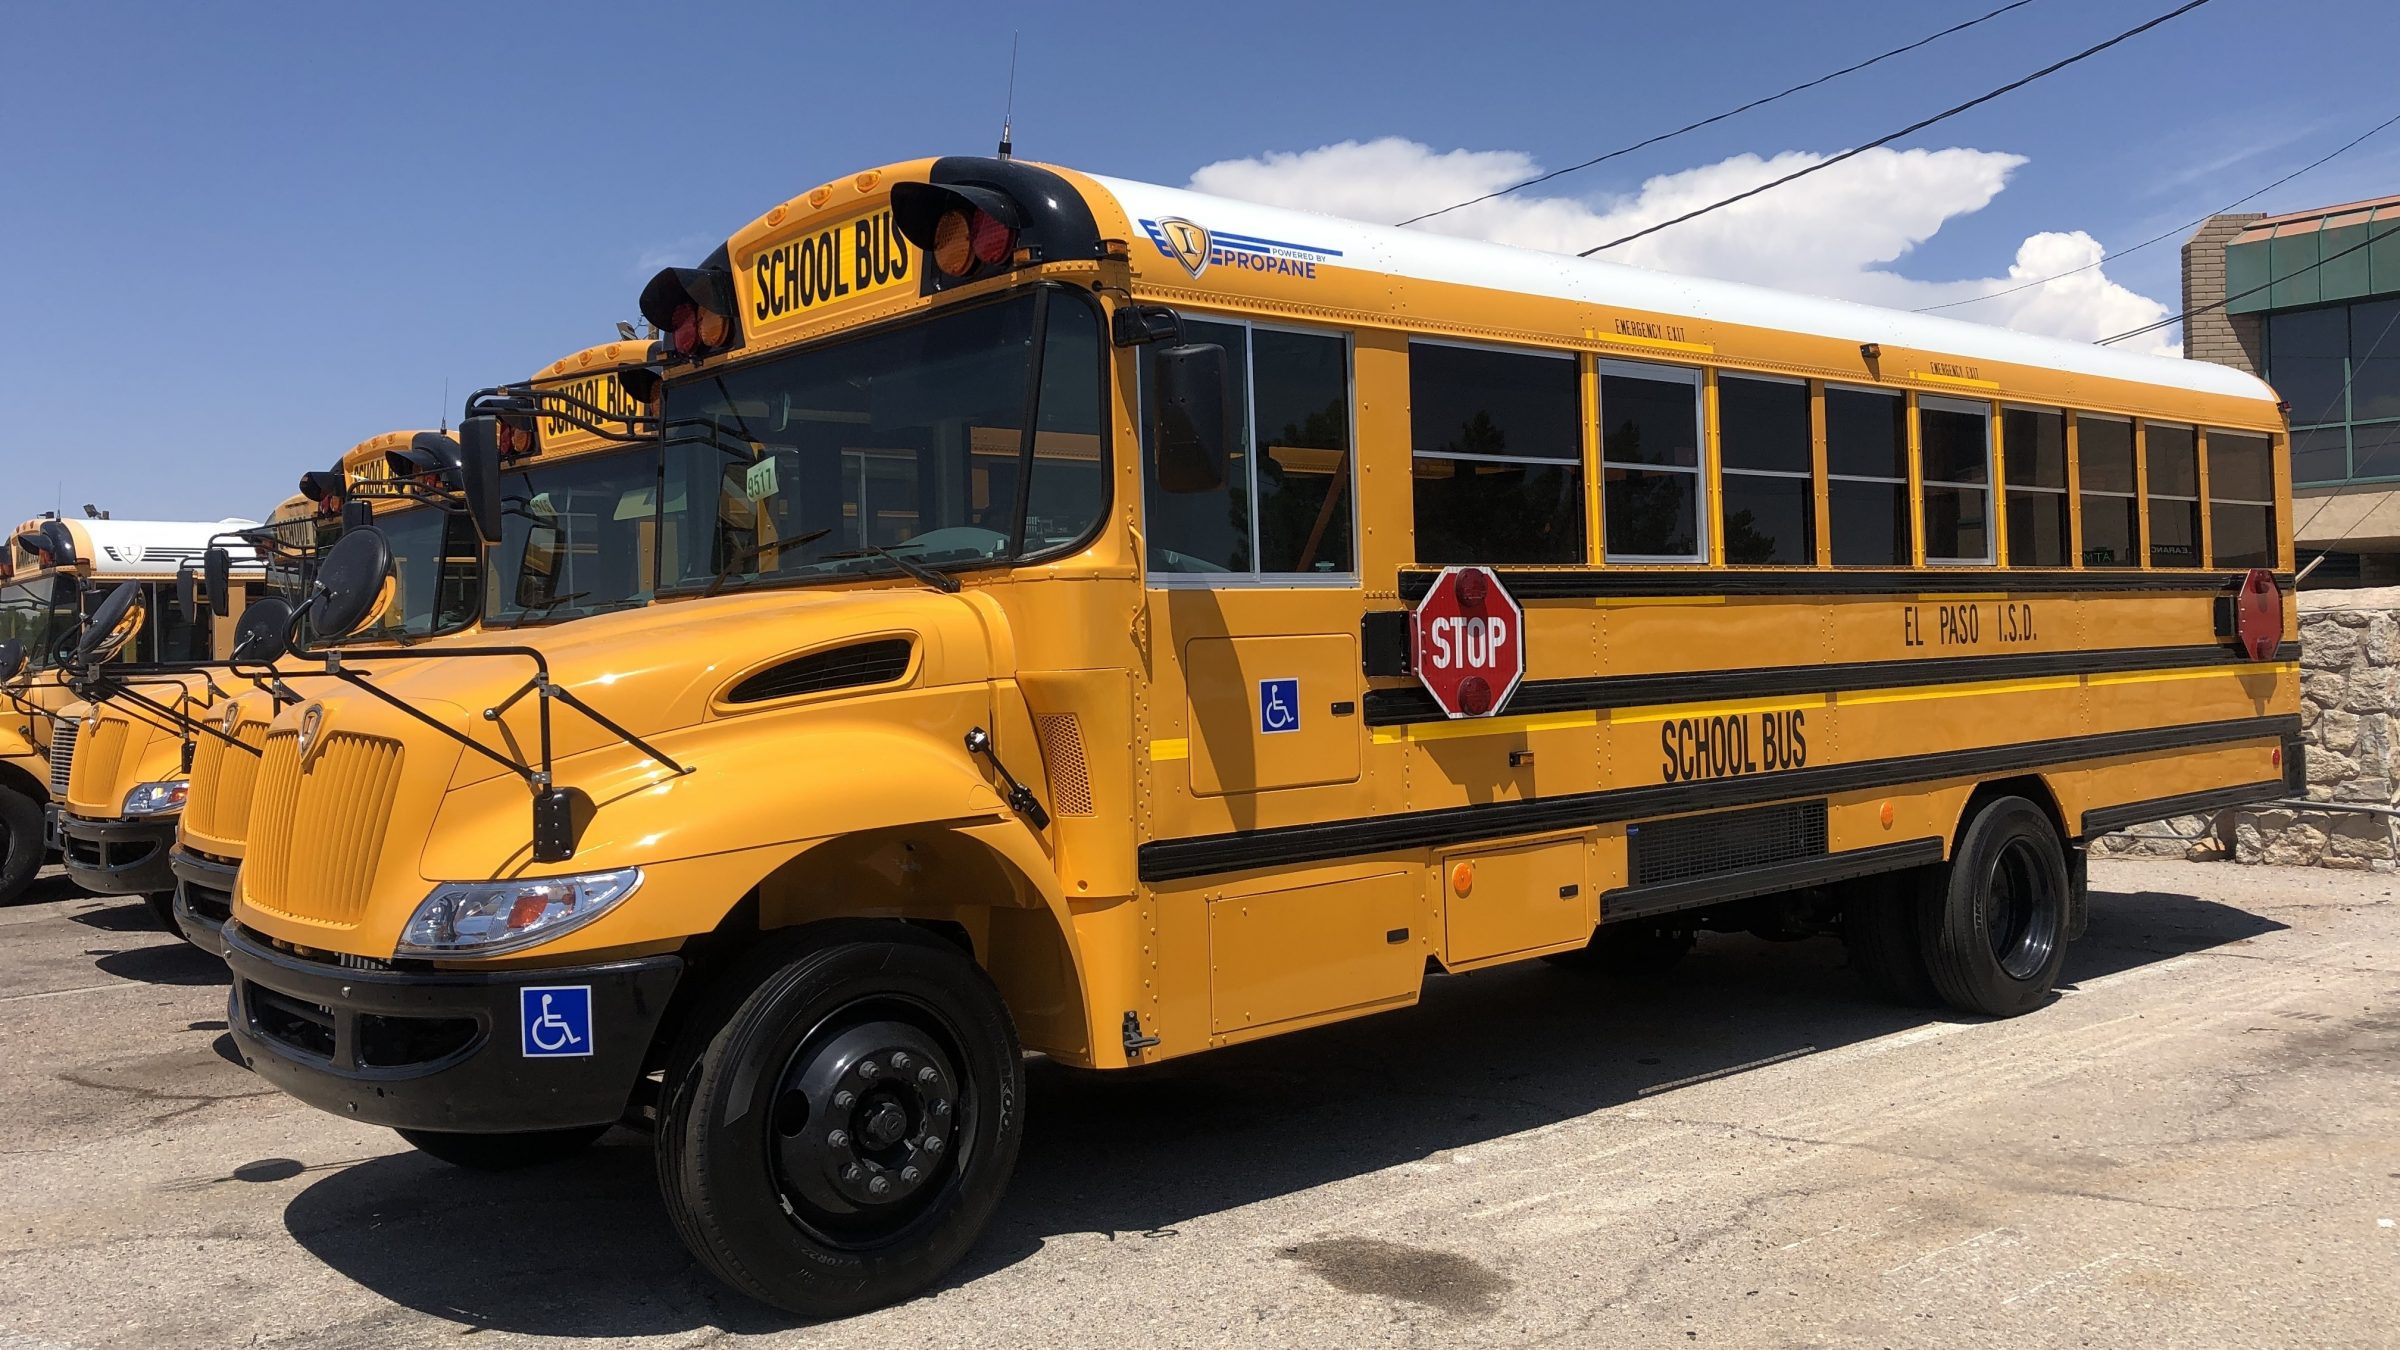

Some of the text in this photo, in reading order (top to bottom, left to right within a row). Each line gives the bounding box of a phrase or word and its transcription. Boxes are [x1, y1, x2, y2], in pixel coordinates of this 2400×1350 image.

[756, 210, 909, 321] SCHOOL BUS
[1224, 250, 1317, 280] PROPANE
[1272, 248, 1326, 263] POWERED BY
[1614, 318, 1686, 343] EMERGENCY EXIT
[1929, 361, 1979, 380] EMERGENCY EXIT
[548, 377, 604, 437] SCHOOL
[748, 468, 772, 498] 9517
[1431, 616, 1507, 669] STOP
[1904, 603, 2037, 646] EL PASO I.S.D.
[1661, 709, 1807, 783] SCHOOL BUS
